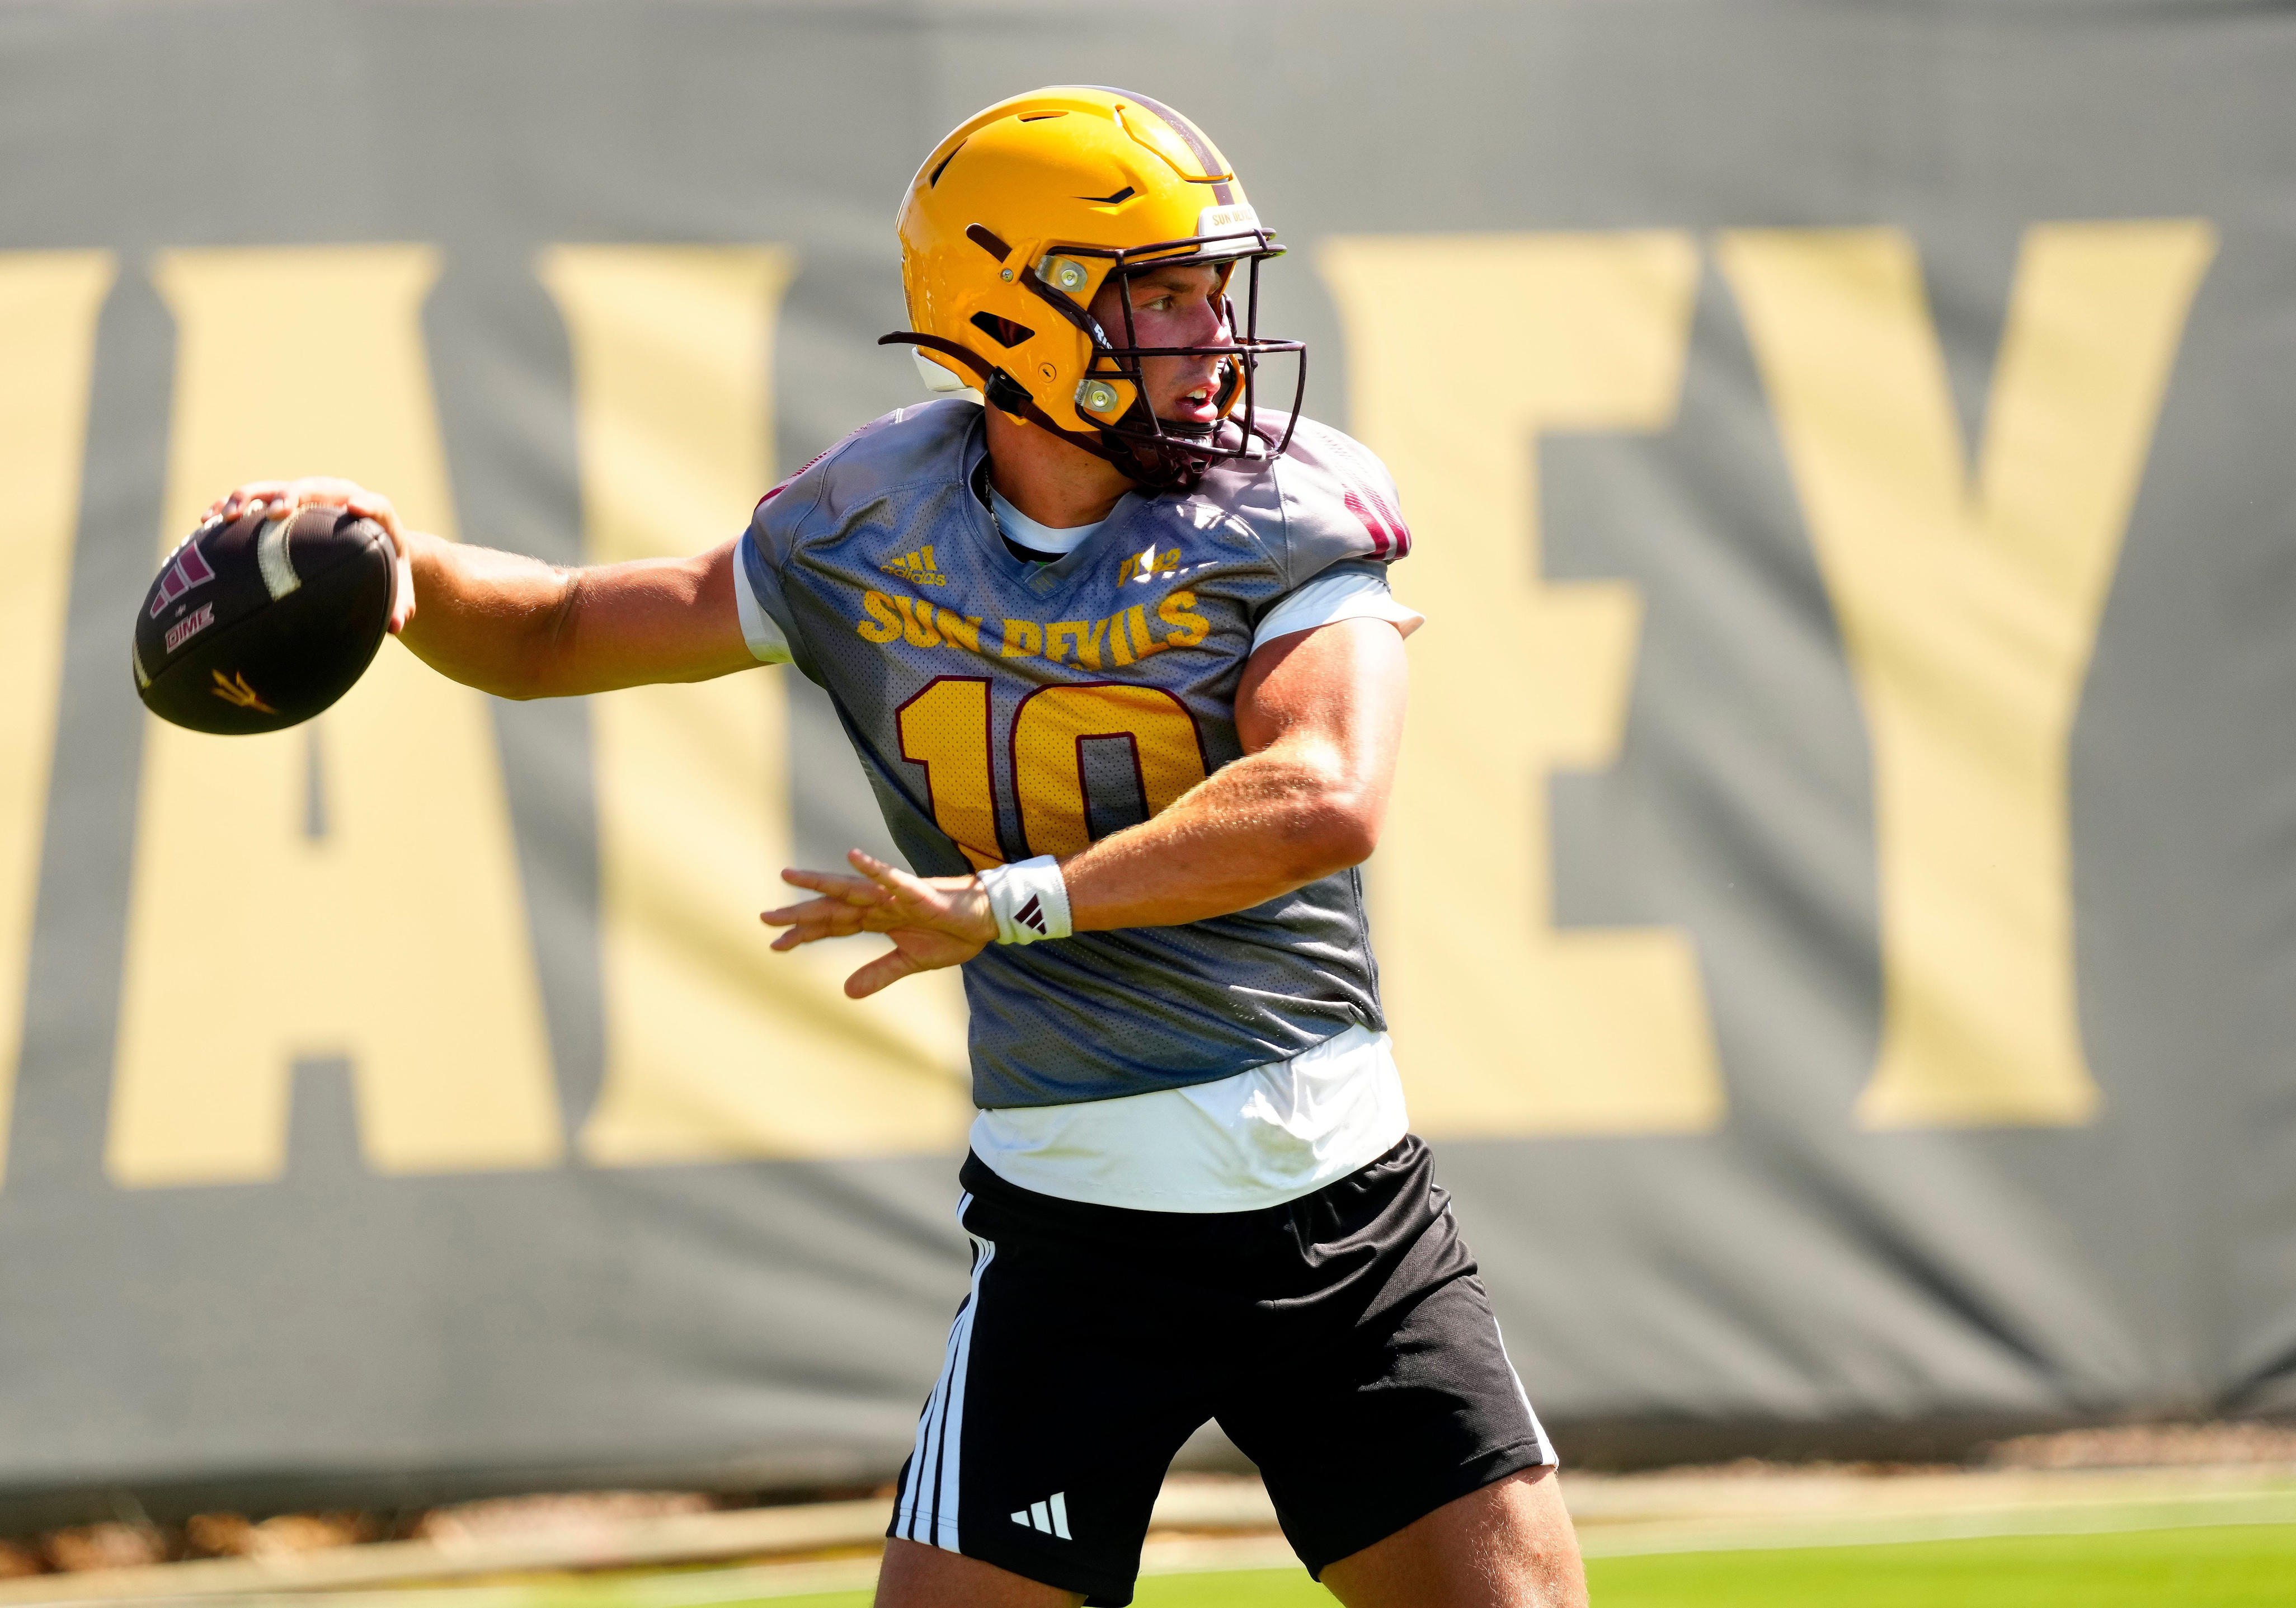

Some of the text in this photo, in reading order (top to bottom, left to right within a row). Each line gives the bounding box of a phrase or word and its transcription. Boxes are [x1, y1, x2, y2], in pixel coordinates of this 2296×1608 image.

[1212, 212, 1232, 227] SUN
[880, 565, 946, 586] adidas
[857, 590, 1211, 671] SUN DEVILS
[895, 674, 1211, 874] 10
